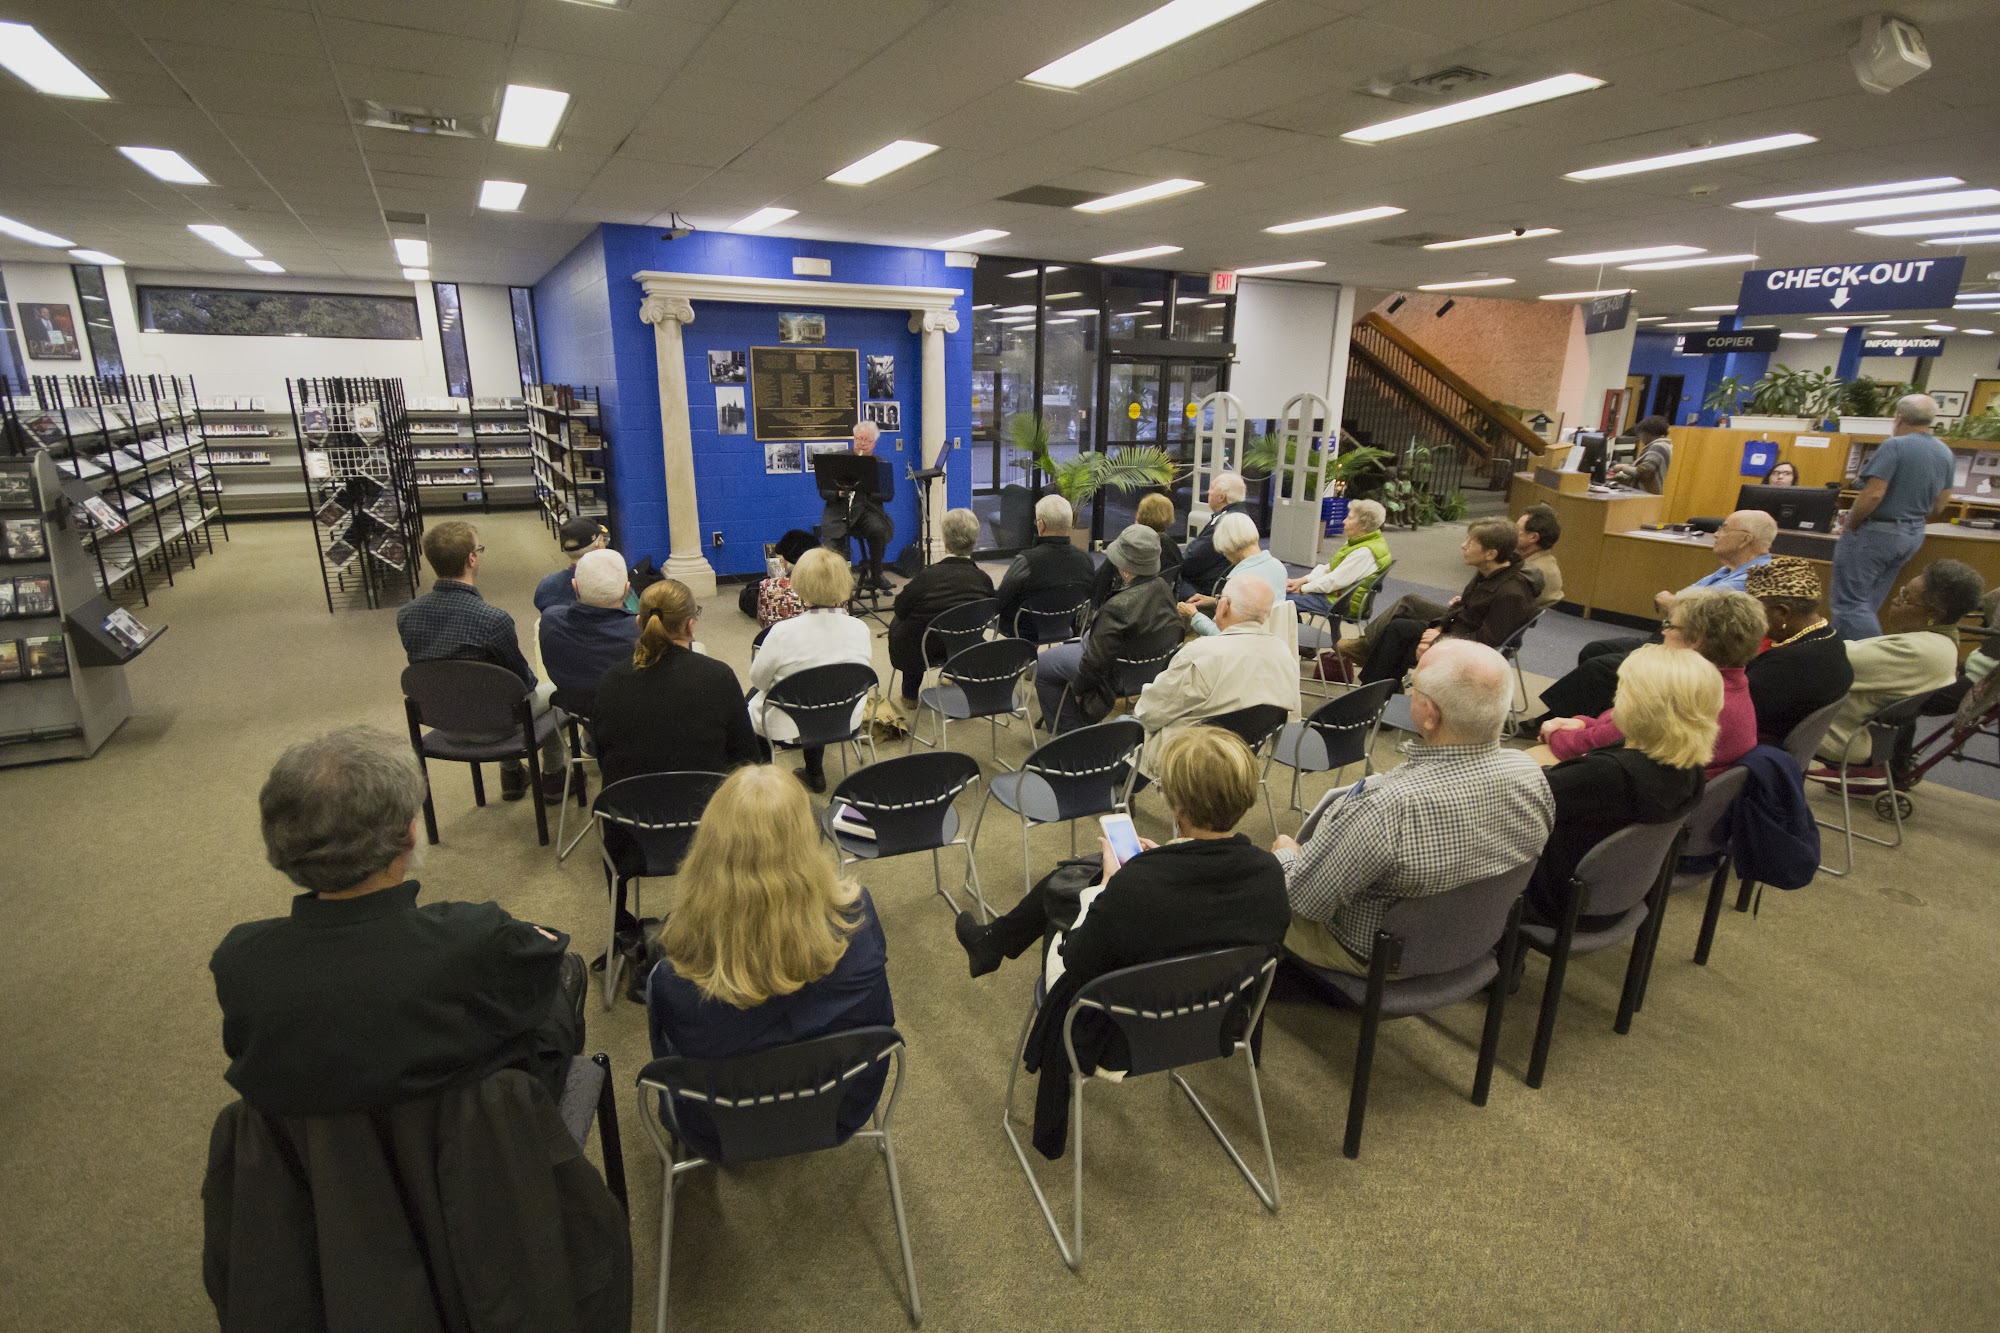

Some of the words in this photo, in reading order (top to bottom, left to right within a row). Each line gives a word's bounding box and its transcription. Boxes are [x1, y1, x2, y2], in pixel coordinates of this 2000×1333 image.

[1216, 273, 1233, 290] EXIT
[1767, 261, 1934, 290] CHECK-OUT
[1707, 337, 1754, 347] COPIER
[1864, 339, 1940, 348] INFORMATION
